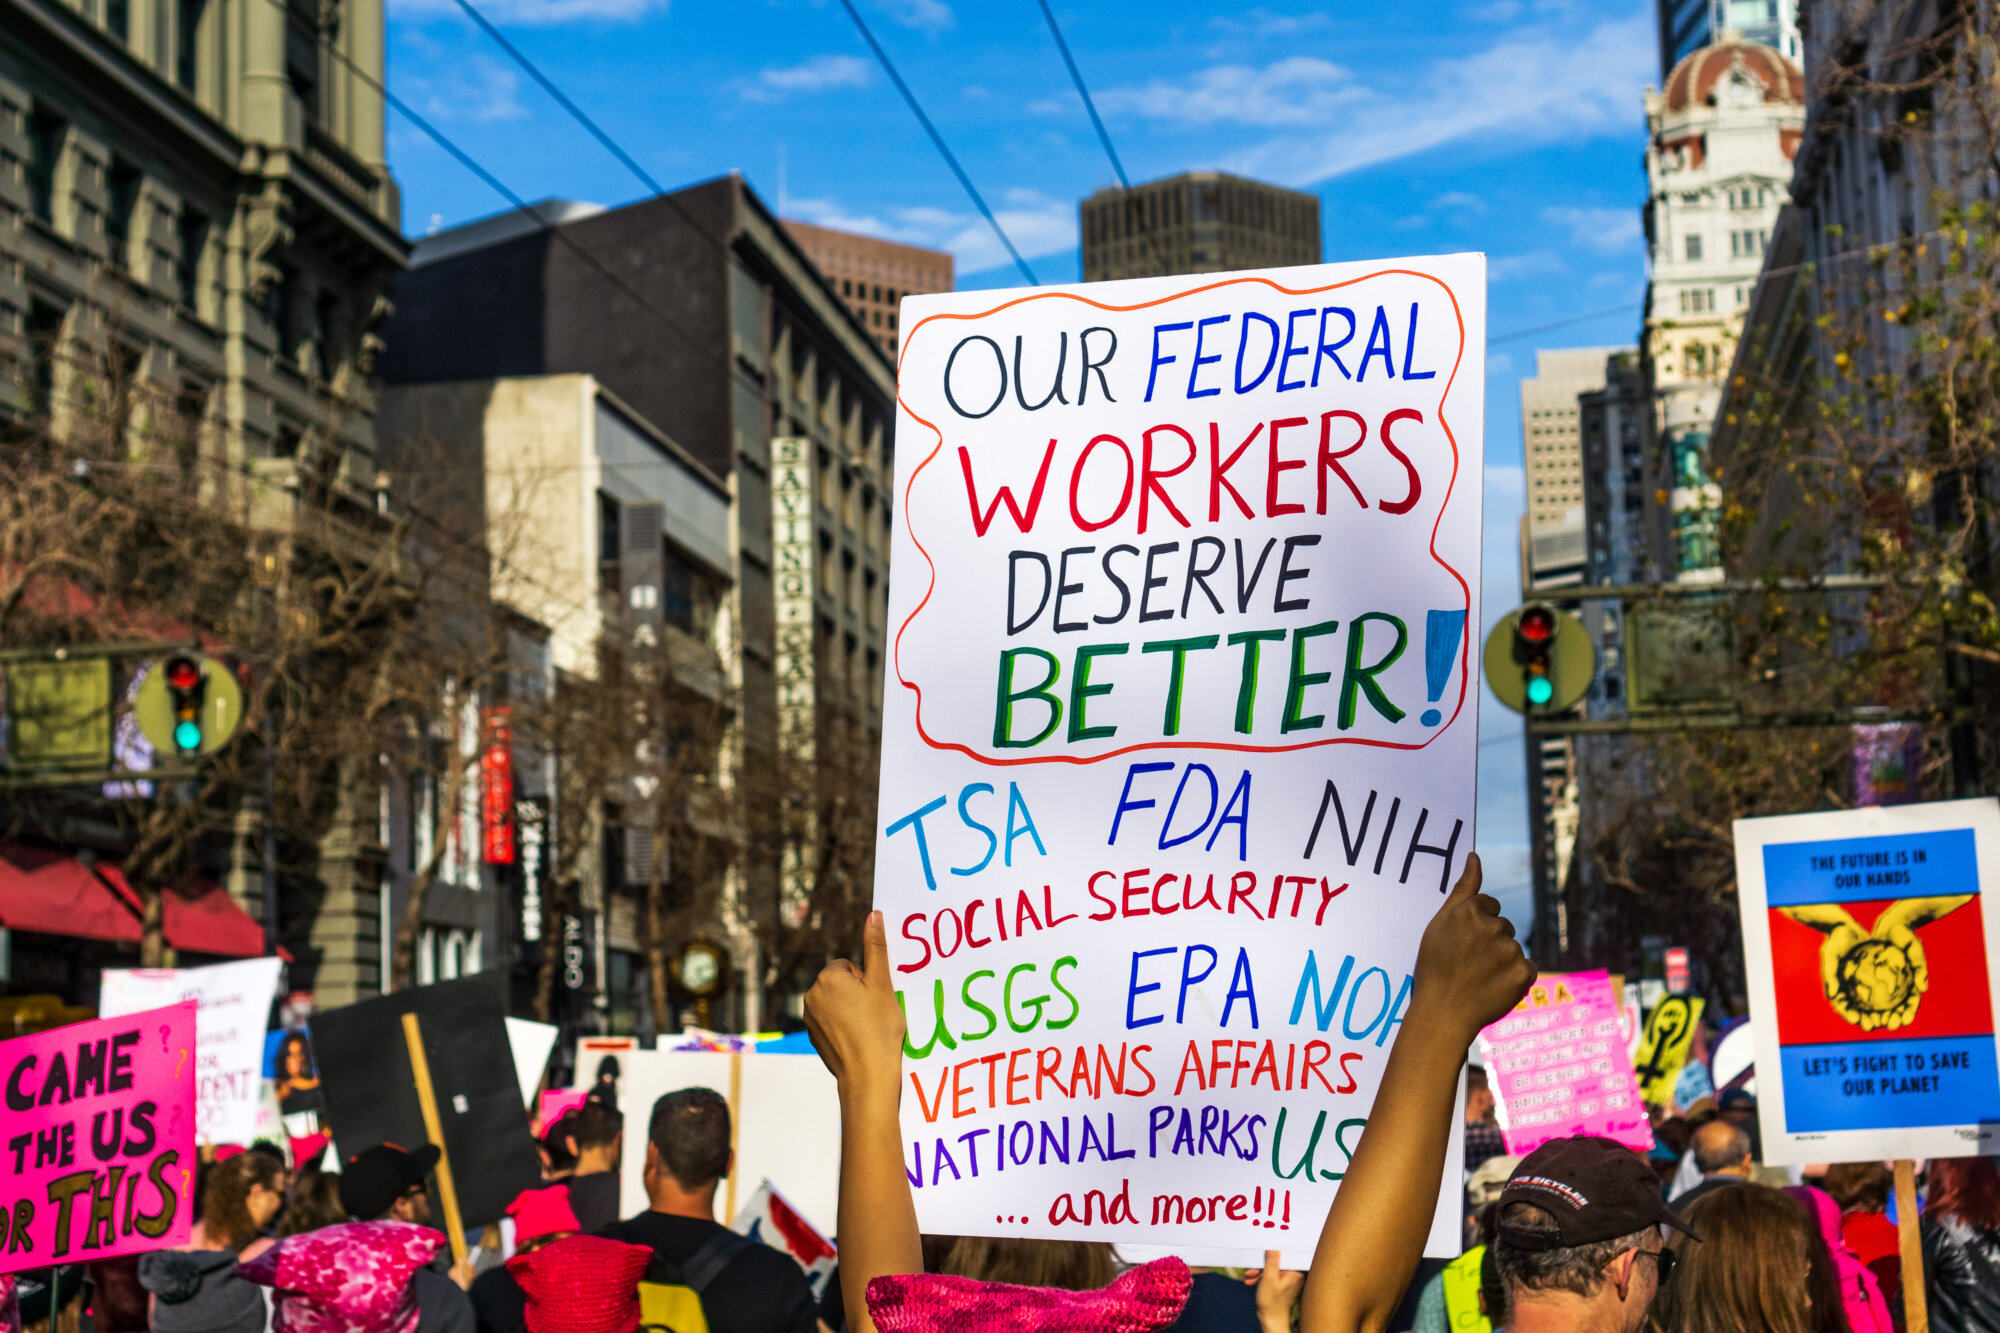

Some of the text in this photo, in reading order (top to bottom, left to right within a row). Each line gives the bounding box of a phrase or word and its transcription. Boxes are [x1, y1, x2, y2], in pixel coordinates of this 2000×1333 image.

[944, 302, 1437, 419] OUR FEDERAL
[957, 408, 1424, 537] WORKERS
[1006, 534, 1322, 636] DESERVE
[992, 608, 1468, 749] BETTER!
[885, 761, 1463, 894] TSA FDA NIH
[1811, 849, 1927, 870] THE FUTURE IS IN
[897, 868, 1349, 974] SOCIAL SECURITY
[1834, 870, 1911, 889] OUR HANDS
[896, 956, 1080, 1060] USGS
[1125, 944, 1260, 1030] EPA
[5, 1030, 141, 1112] CAME
[909, 1039, 1363, 1123] VETERANS AFFAIRS
[1804, 1051, 1971, 1076] LET'S FIGHT TO SAVE
[1843, 1076, 1940, 1096] OUR PLANET
[9, 1121, 75, 1175] THE
[91, 1100, 157, 1162] US
[1149, 1105, 1266, 1160] PARKS
[46, 1149, 180, 1258] THIS
[1048, 1179, 1138, 1227] and
[1151, 1185, 1291, 1230] more!!!
